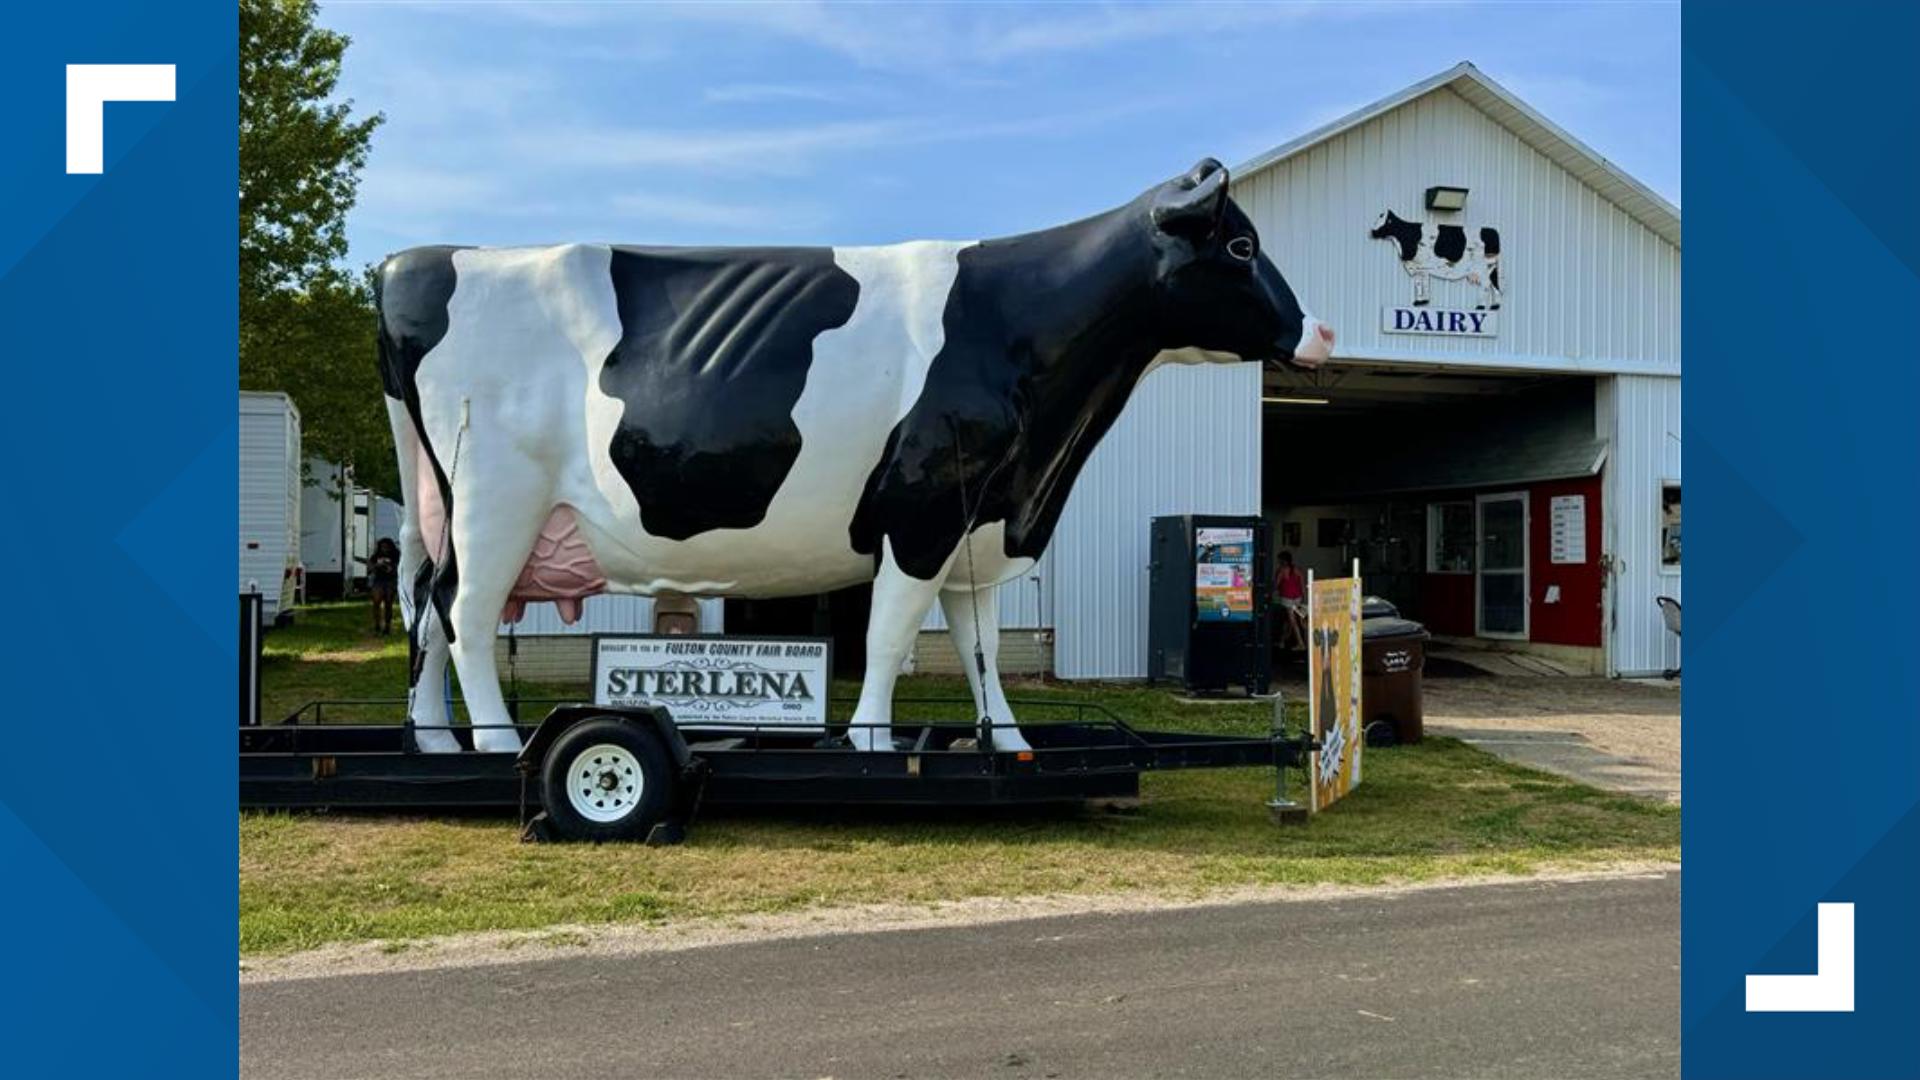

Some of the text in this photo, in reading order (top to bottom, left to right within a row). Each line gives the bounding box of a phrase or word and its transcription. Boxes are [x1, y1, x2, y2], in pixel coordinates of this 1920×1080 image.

[1394, 309, 1488, 333] DAIRY
[665, 642, 707, 655] FULTON
[709, 643, 754, 656] COUNTY
[756, 644, 781, 656] FAIR
[785, 645, 822, 657] BOARD
[607, 669, 814, 701] STERLENA
